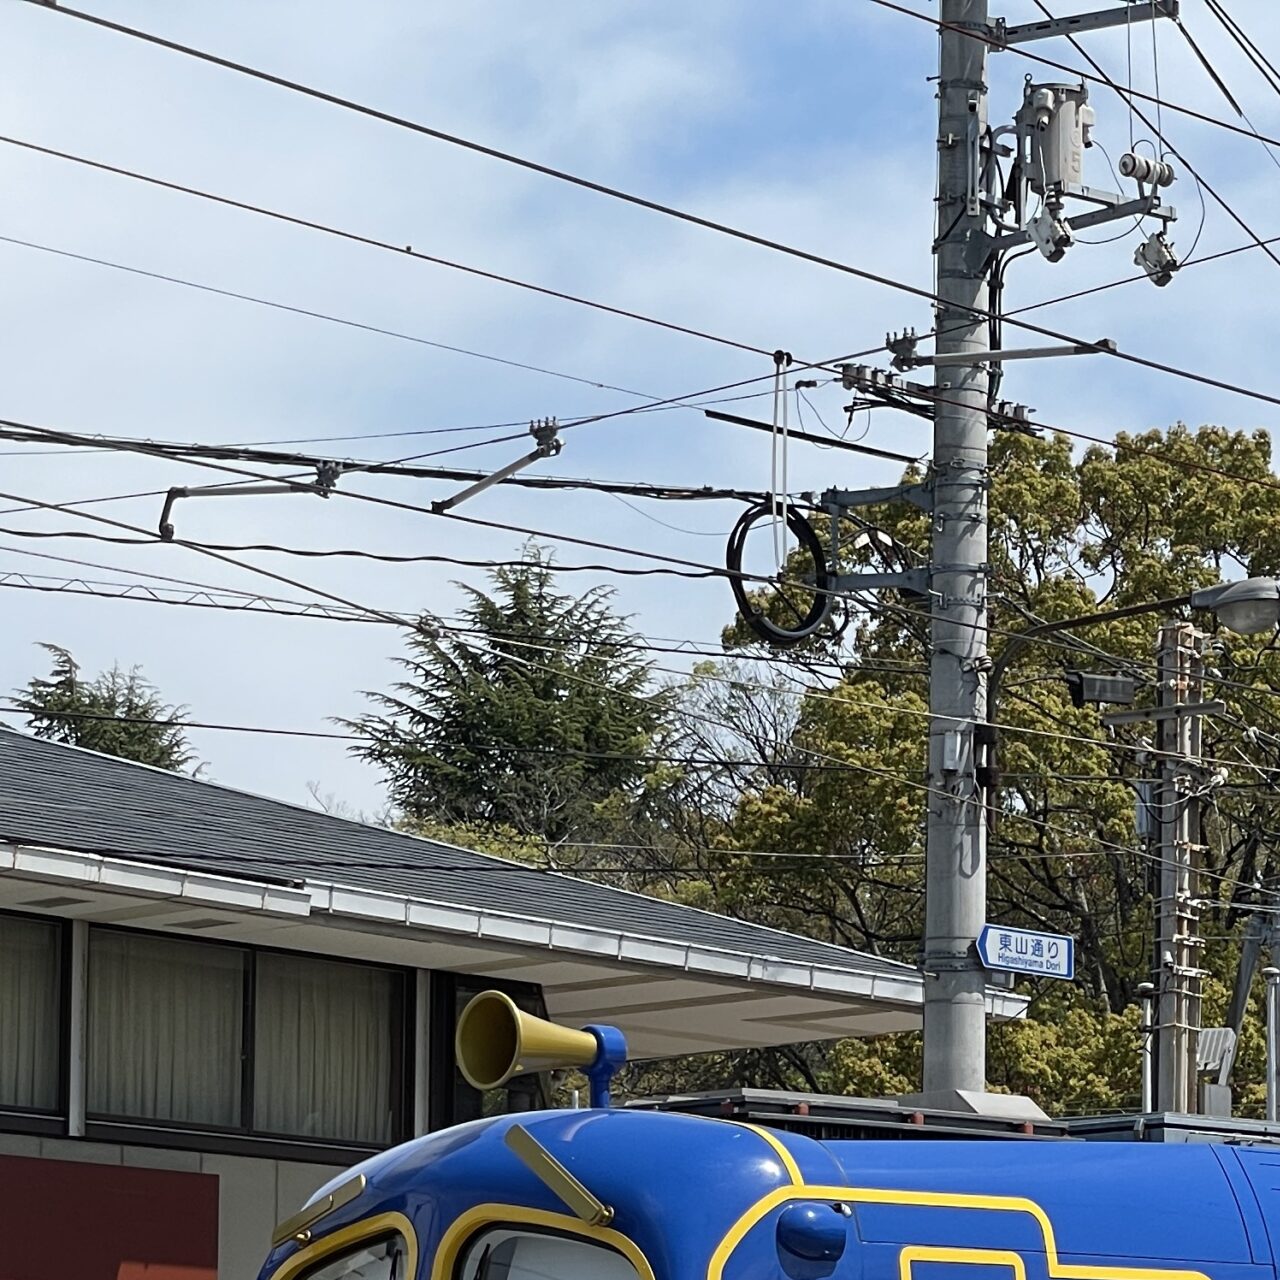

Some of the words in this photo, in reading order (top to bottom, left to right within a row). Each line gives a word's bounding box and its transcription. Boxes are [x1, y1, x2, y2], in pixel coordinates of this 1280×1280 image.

[999, 934, 1059, 959] 東山通り
[998, 952, 1044, 968] Higashiyama
[1046, 960, 1061, 971] Dori
